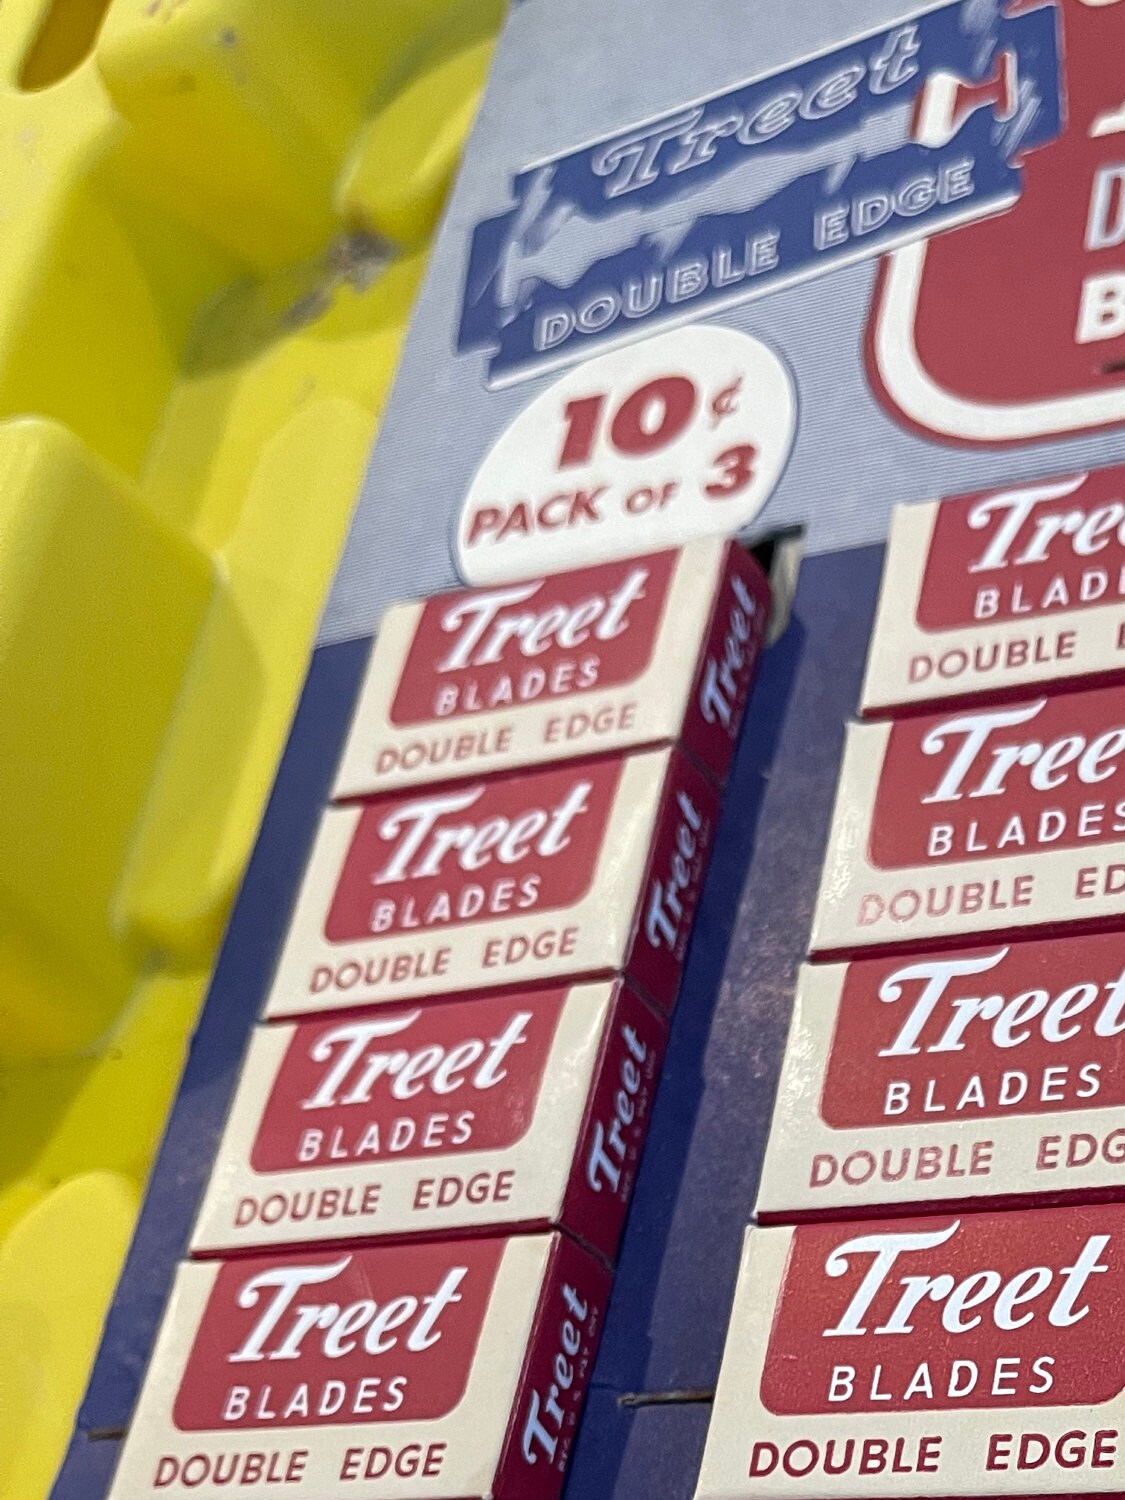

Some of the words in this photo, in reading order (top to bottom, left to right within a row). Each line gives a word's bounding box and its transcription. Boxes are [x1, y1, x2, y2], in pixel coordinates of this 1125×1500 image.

[592, 22, 922, 200] Treet
[534, 229, 781, 351] DOUBLE
[814, 157, 976, 251] EDGE
[467, 484, 611, 546] PACK
[705, 444, 757, 498] 3
[437, 565, 650, 674] Treet
[436, 659, 598, 715] BLADES
[909, 631, 1076, 682] DOUBLE
[375, 727, 512, 774] DOUBLE
[543, 702, 636, 743] EDGE
[374, 783, 591, 884] Treet
[648, 794, 700, 946] Treet
[859, 875, 1034, 924] DOUBLE
[372, 877, 540, 931] BLADES
[309, 947, 451, 994] DOUBLE
[482, 927, 578, 968] EDGE
[303, 1011, 532, 1109] Treet
[884, 1064, 1101, 1114] BLADES
[299, 1111, 474, 1161] BLADES
[588, 1026, 645, 1191] Treet
[809, 1141, 994, 1188] DOUBLE
[234, 1184, 381, 1227] DOUBLE
[413, 1170, 515, 1209] EDGE
[229, 1256, 467, 1362] Treet
[823, 1220, 1111, 1336] Treet
[224, 1377, 407, 1420] BLADES
[523, 1285, 587, 1463] Treet
[829, 1357, 1054, 1401] BLADES
[153, 1451, 308, 1487] DOUBLE
[340, 1443, 447, 1480] EDGE
[749, 1436, 942, 1477] DOUBLE
[986, 1430, 1118, 1471] EDGE
